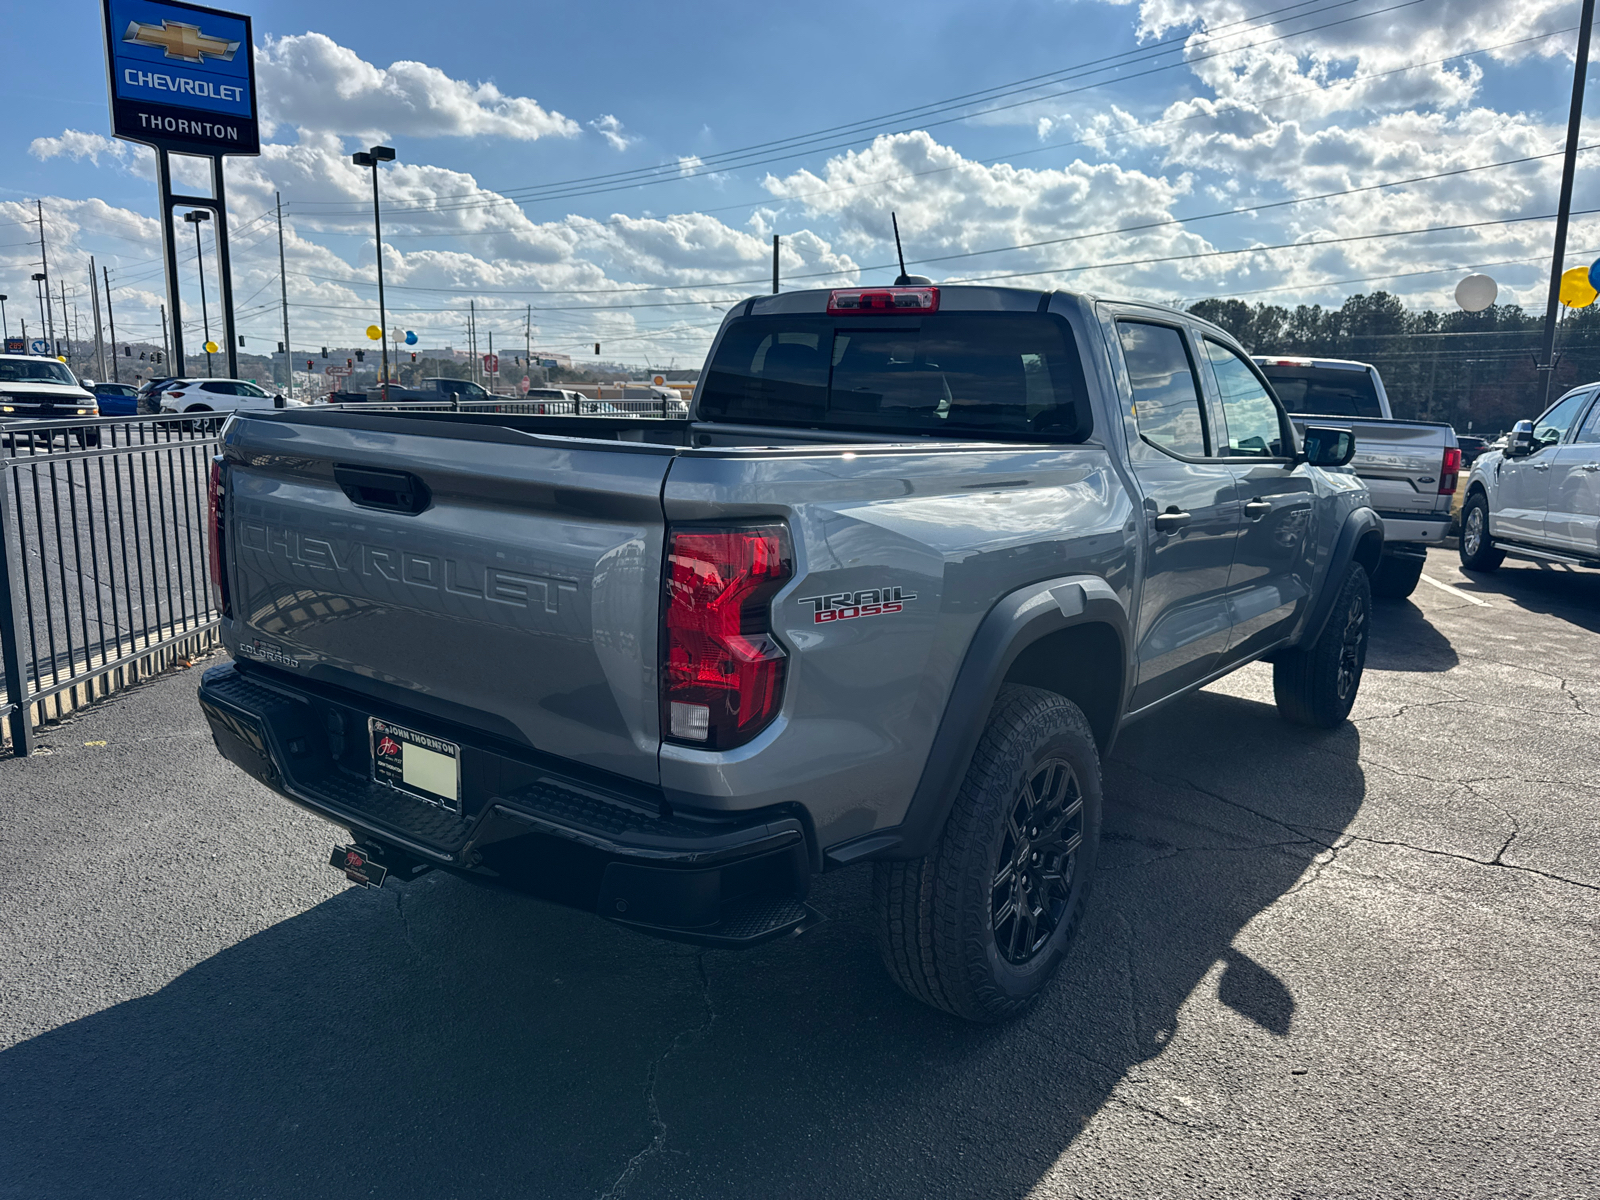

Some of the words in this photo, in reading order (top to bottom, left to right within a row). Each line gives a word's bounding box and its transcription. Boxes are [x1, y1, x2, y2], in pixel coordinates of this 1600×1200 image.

[124, 69, 243, 102] CHEVROLET
[138, 113, 238, 140] THORNTON
[240, 520, 579, 613] CHEVROLET
[798, 586, 917, 611] TRAIL
[814, 601, 903, 624] BOSS
[240, 643, 299, 667] COLORADO
[389, 726, 410, 740] JOHN
[410, 733, 455, 755] THORNTON
